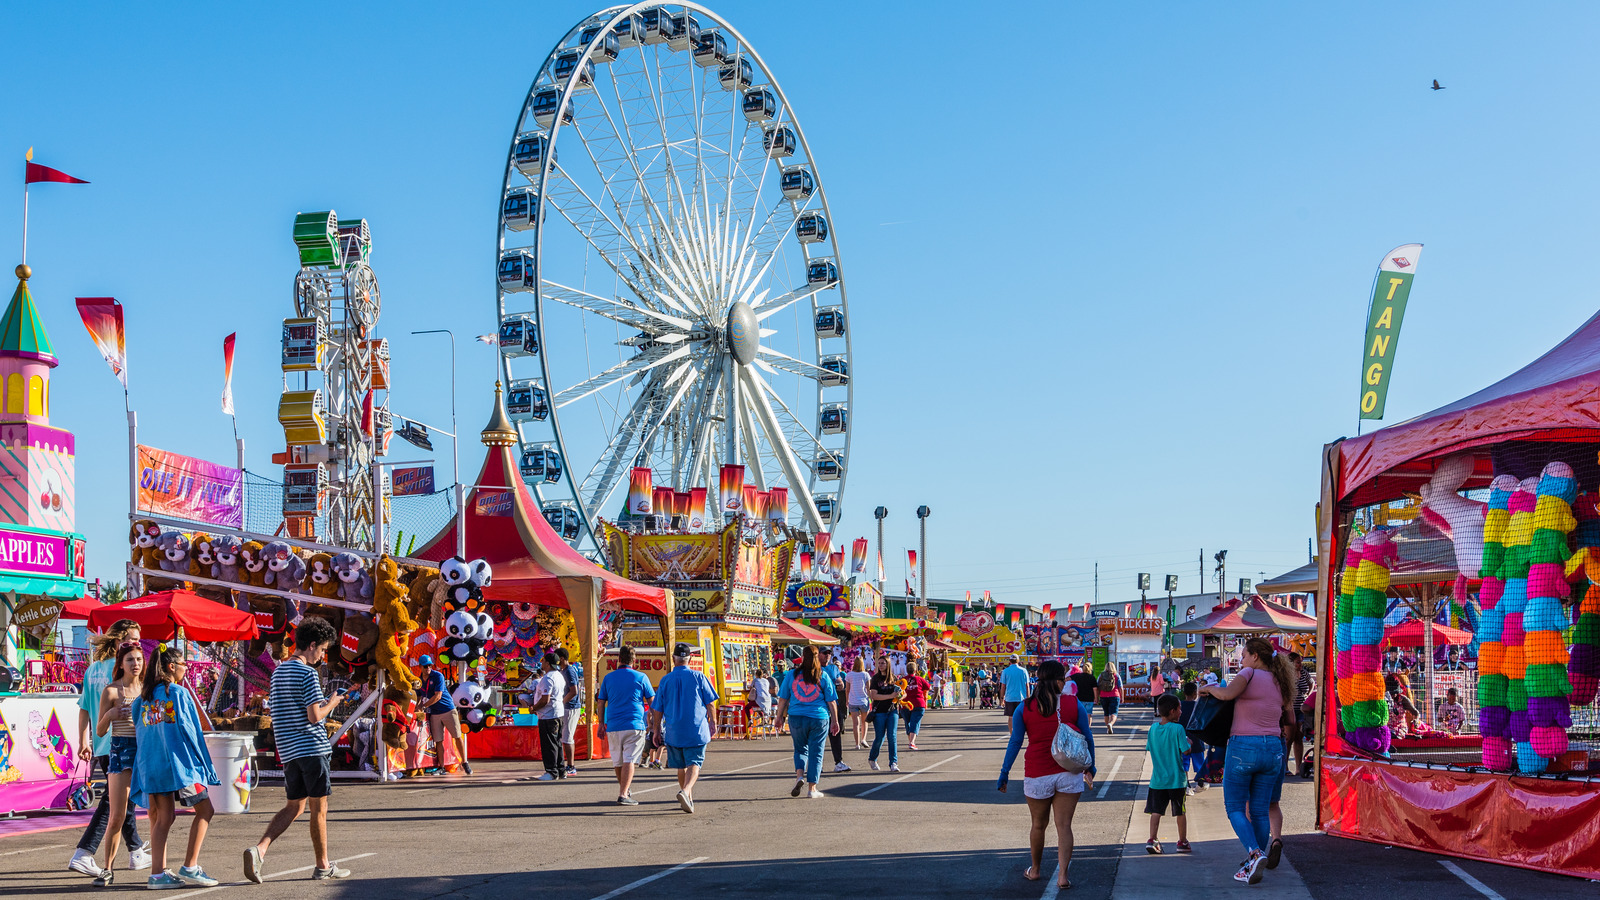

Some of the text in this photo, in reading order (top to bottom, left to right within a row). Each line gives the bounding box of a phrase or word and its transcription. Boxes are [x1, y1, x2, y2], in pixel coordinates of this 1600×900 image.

[1361, 278, 1404, 413] TANGO
[140, 466, 175, 494] ONE
[395, 467, 427, 485] ONE IN
[403, 476, 431, 493] WINS
[478, 492, 510, 506] ONE IN
[486, 501, 512, 514] WINS
[0, 537, 54, 566] APPLES
[798, 586, 830, 598] BALLOON
[734, 598, 771, 617] HOT DOGS
[803, 596, 825, 606] POP
[14, 605, 59, 625] Kettle Corn
[1119, 618, 1160, 629] TICKETS
[950, 635, 1001, 648] NNEL
[964, 641, 1015, 654] AKES
[606, 658, 667, 671] NCHO
